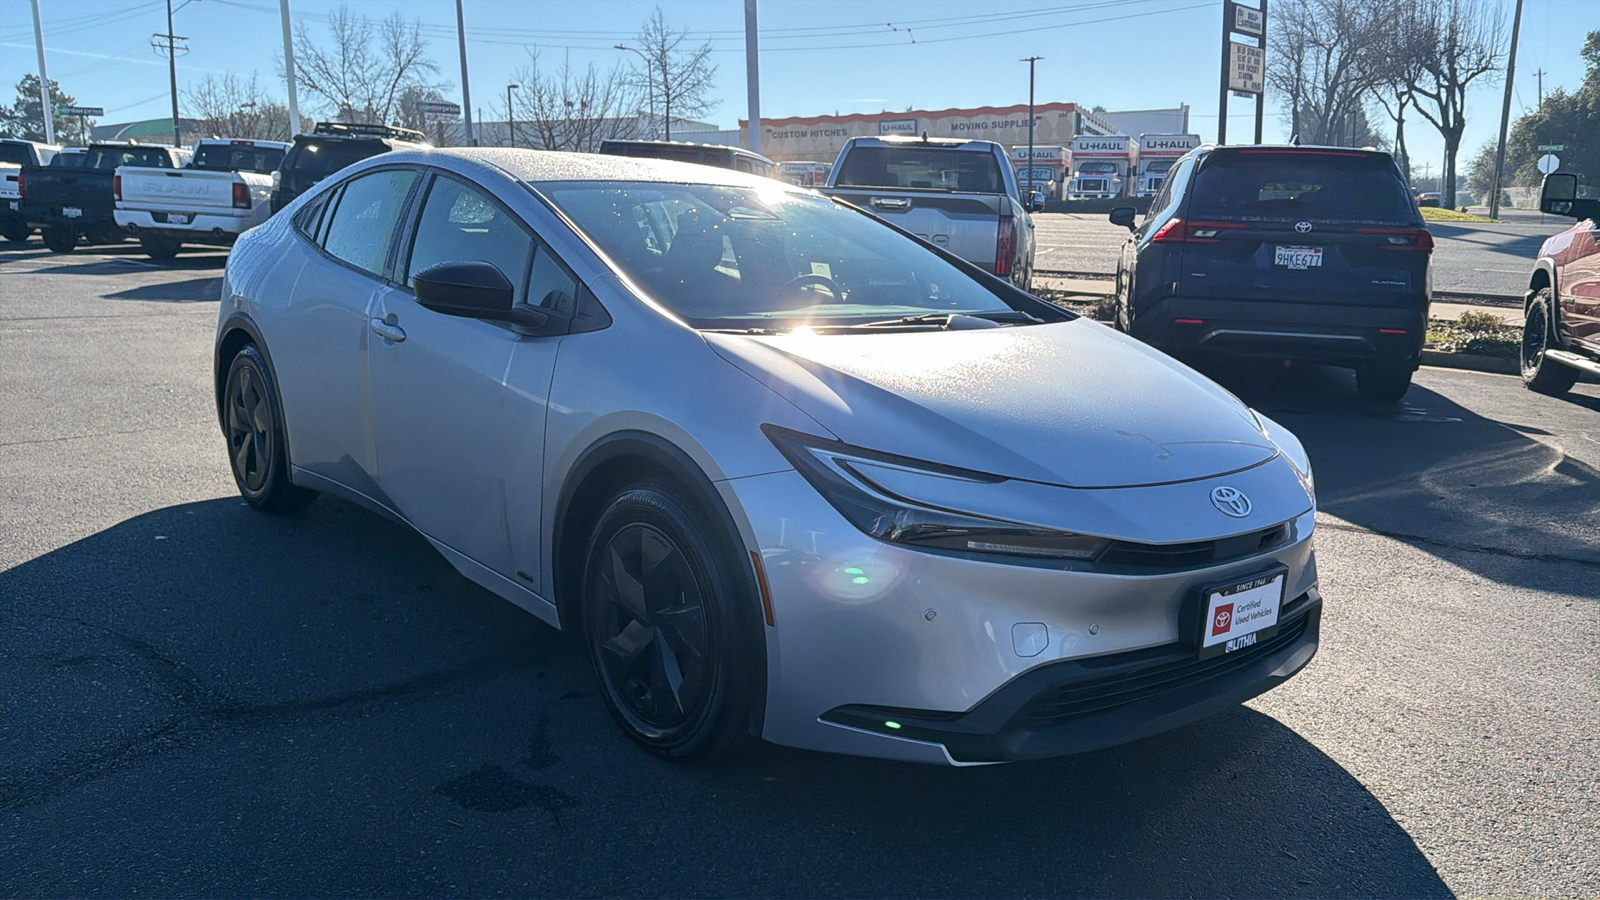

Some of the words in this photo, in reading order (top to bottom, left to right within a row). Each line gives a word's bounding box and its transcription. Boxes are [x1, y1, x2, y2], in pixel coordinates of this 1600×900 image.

[882, 123, 914, 132] U-HAUL
[951, 121, 988, 131] MOVING
[991, 119, 1037, 129] SUPPLIES
[771, 130, 808, 139] CUSTOM
[810, 128, 848, 138] HITCHES
[1079, 142, 1123, 151] U-HAUL
[1146, 140, 1193, 149] U-HAUL
[143, 183, 209, 194] RAM
[1277, 253, 1321, 266] 9HKE677
[1236, 582, 1253, 592] SINCE
[1236, 599, 1262, 613] Certified
[1235, 615, 1250, 625] Used
[1250, 608, 1272, 621] Vehicles
